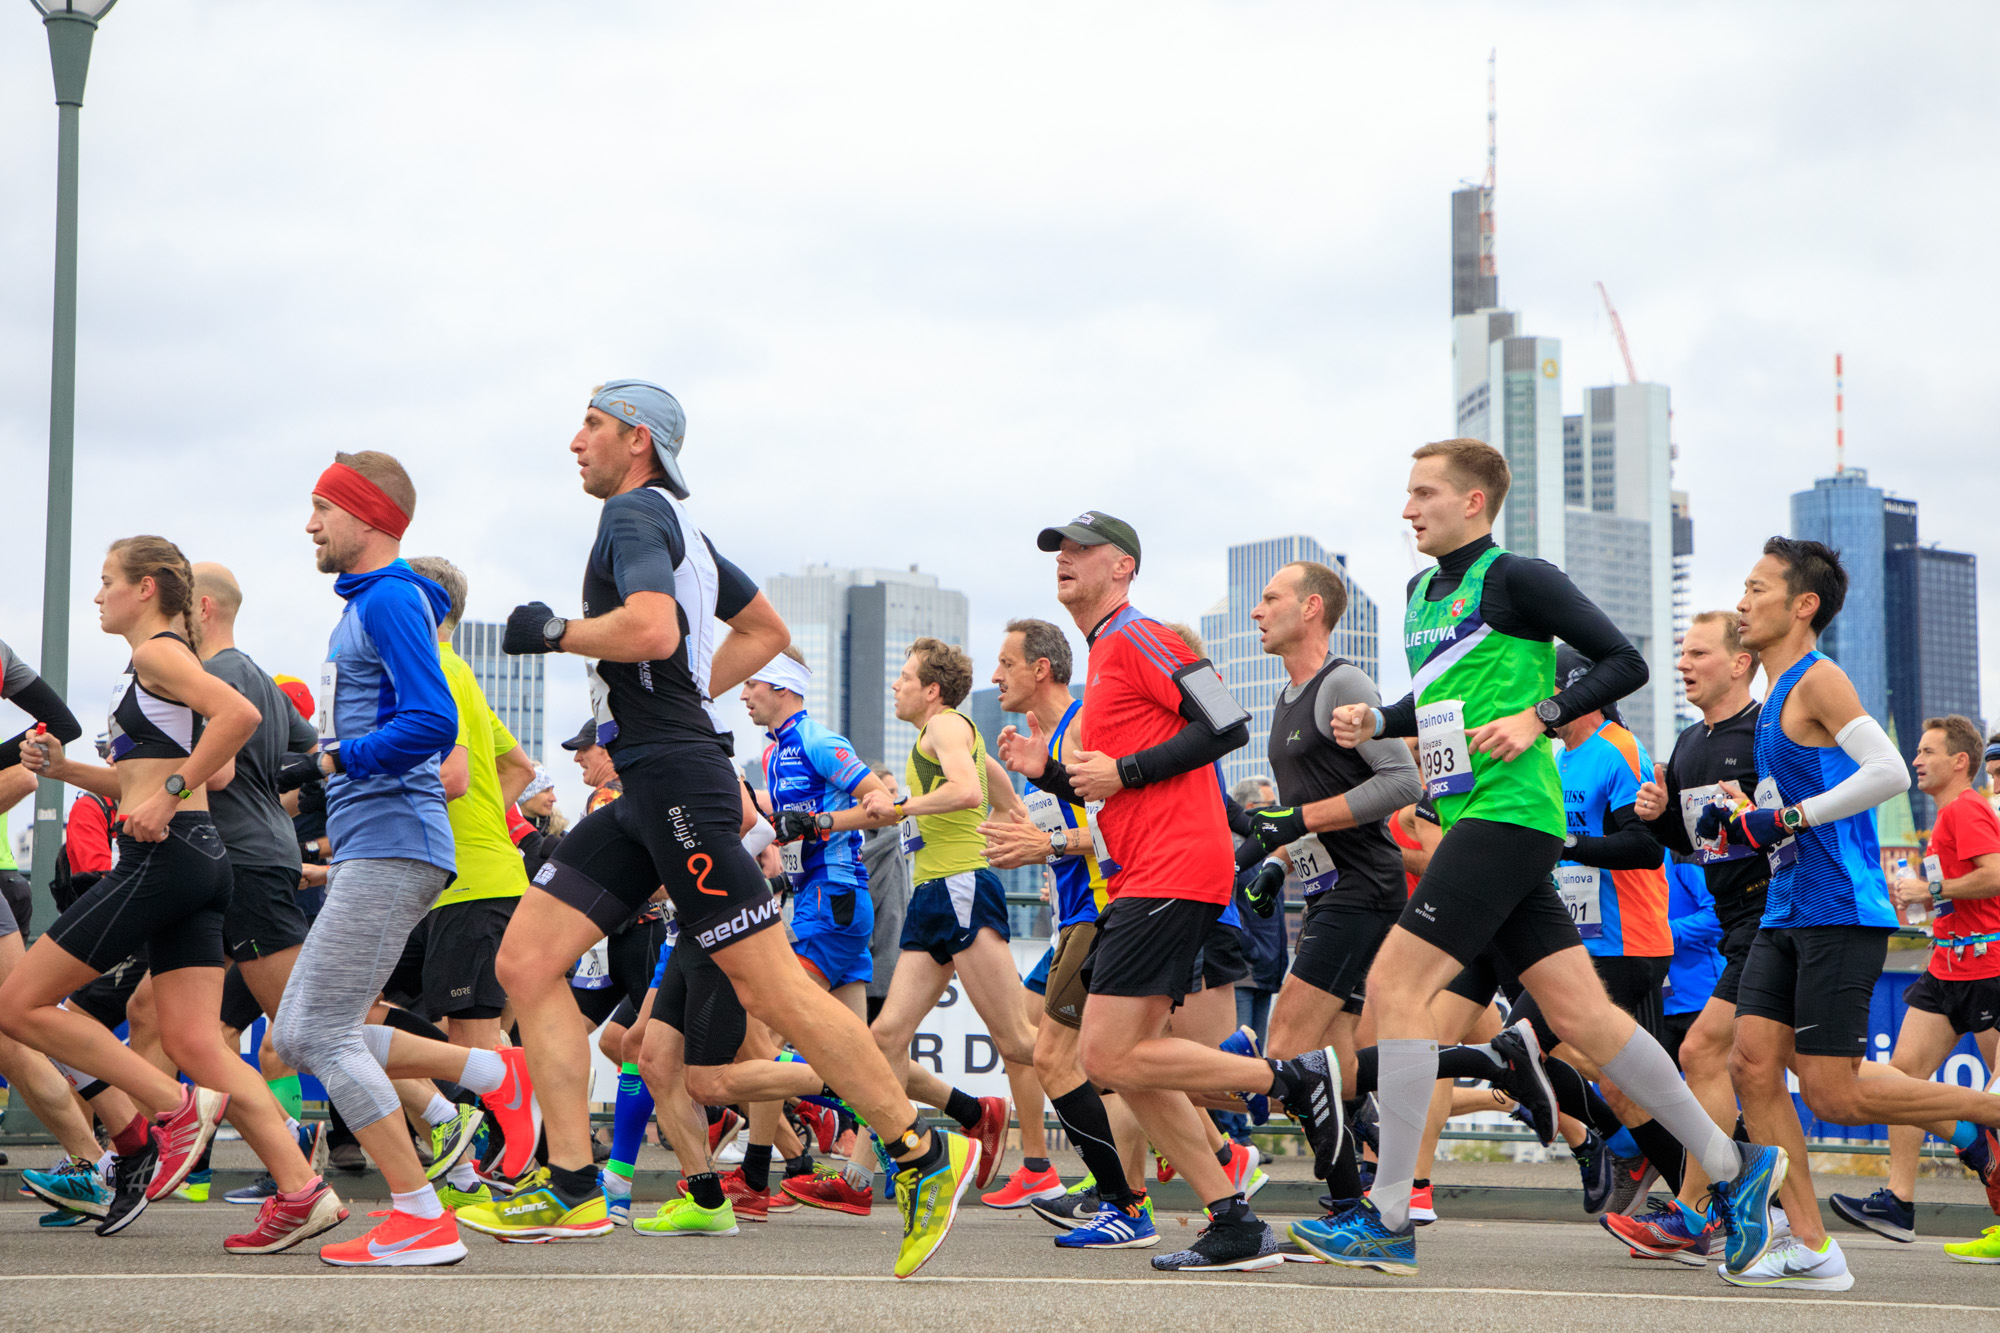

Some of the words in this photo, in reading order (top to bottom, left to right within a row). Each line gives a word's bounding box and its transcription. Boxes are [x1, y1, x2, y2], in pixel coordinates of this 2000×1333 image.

[1406, 625, 1457, 648] LIETUVA
[1417, 711, 1455, 730] mainova
[1725, 758, 1738, 766] HH
[668, 806, 696, 850] affinia
[1291, 852, 1319, 879] 061
[1415, 908, 1436, 922] erima
[1567, 902, 1588, 922] 01
[450, 986, 471, 998] GORE
